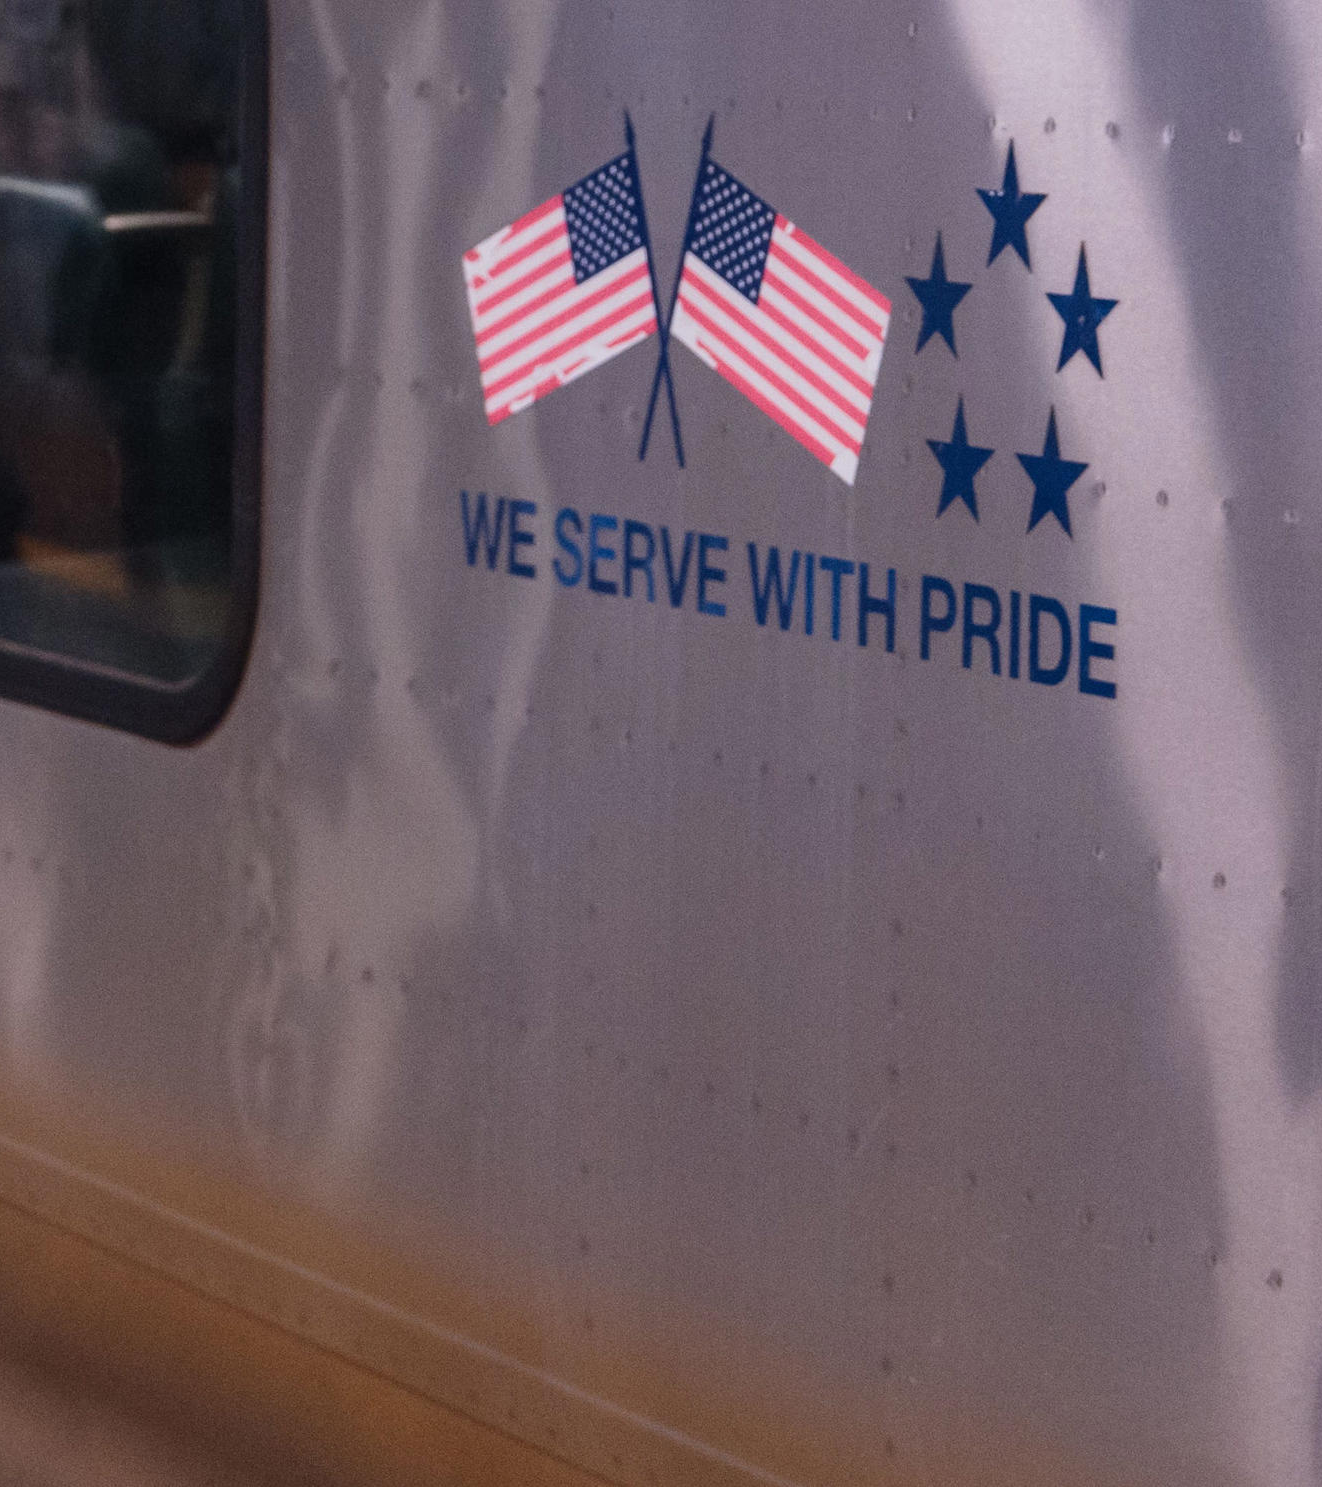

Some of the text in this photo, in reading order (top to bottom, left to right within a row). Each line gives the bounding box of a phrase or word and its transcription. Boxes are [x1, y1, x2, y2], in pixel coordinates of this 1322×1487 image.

[460, 490, 1118, 700] WE SERVE WITH PRIDE
